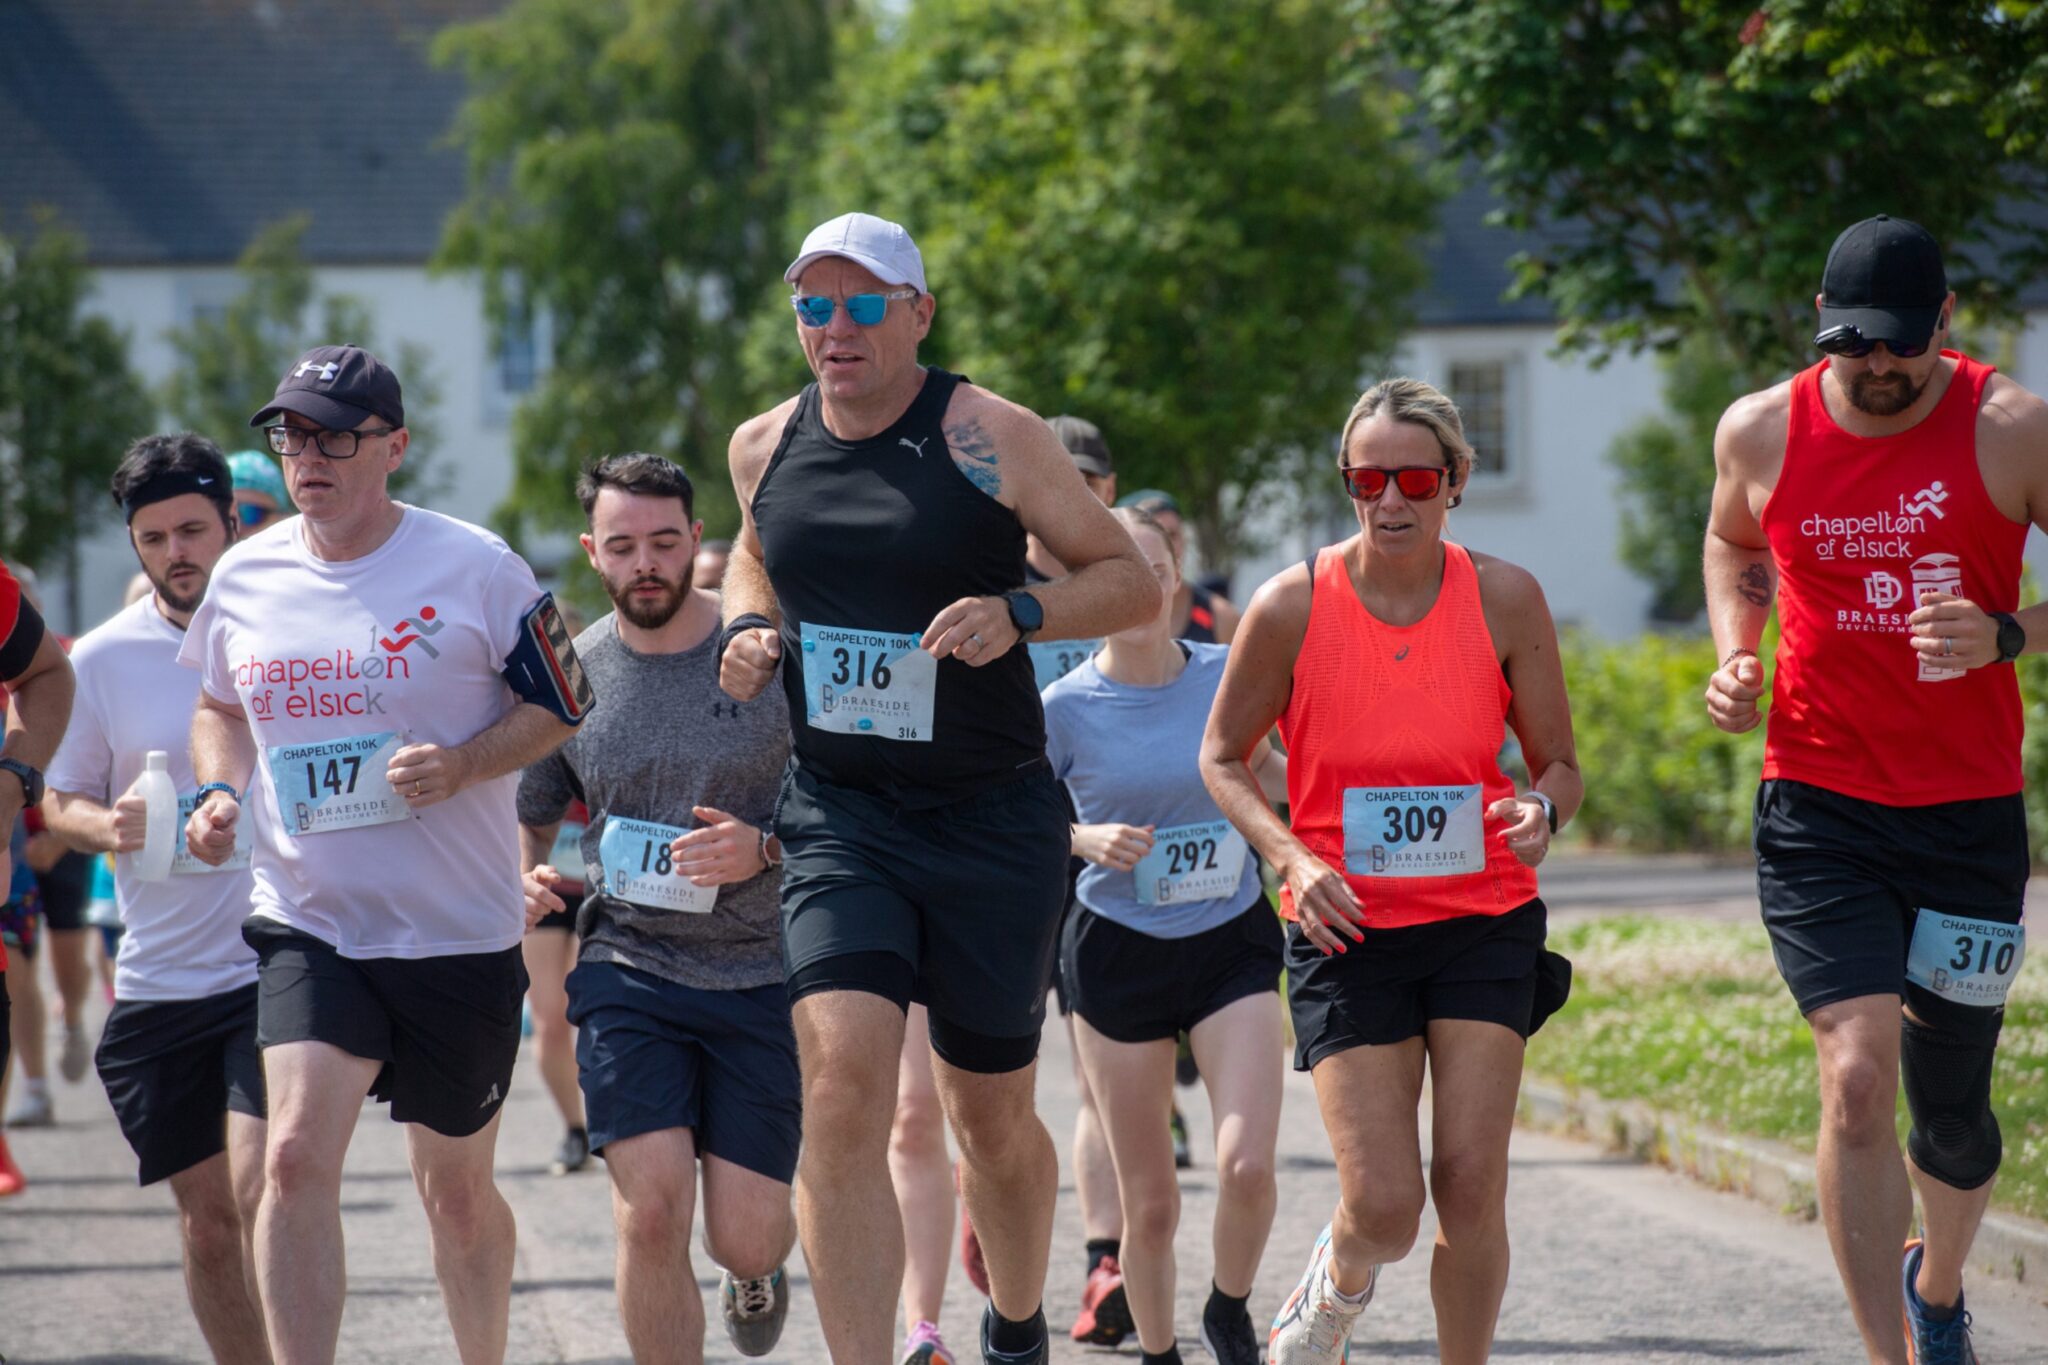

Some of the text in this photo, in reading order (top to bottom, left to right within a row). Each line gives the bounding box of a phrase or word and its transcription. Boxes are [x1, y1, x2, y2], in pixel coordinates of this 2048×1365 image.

[1816, 536, 1913, 560] of elsick
[1837, 610, 1910, 625] BRAESI
[1837, 623, 1914, 633] DEVELOPME
[819, 631, 912, 650] CHAPELTON 10K
[831, 647, 892, 690] 316
[252, 684, 387, 720] of elsick
[842, 696, 911, 711] BRAESIDE
[898, 727, 917, 739] 316
[284, 739, 377, 761] CHAPELTON 10K
[306, 755, 362, 799] 147
[1365, 791, 1465, 802] CHAPELTON 10K
[316, 799, 388, 818] BRAESIDE
[620, 821, 681, 839] CHAPELTON
[1155, 826, 1209, 840] HAPELTON
[1383, 805, 1447, 843] 309
[641, 840, 672, 876] 18
[1166, 838, 1218, 875] 292
[1395, 851, 1466, 862] BRAESIDE
[633, 881, 695, 899] BRAESIDE
[1941, 919, 2015, 938] CHAPELTON
[1949, 936, 2015, 975] 310
[1956, 981, 2010, 992] BRAESI
